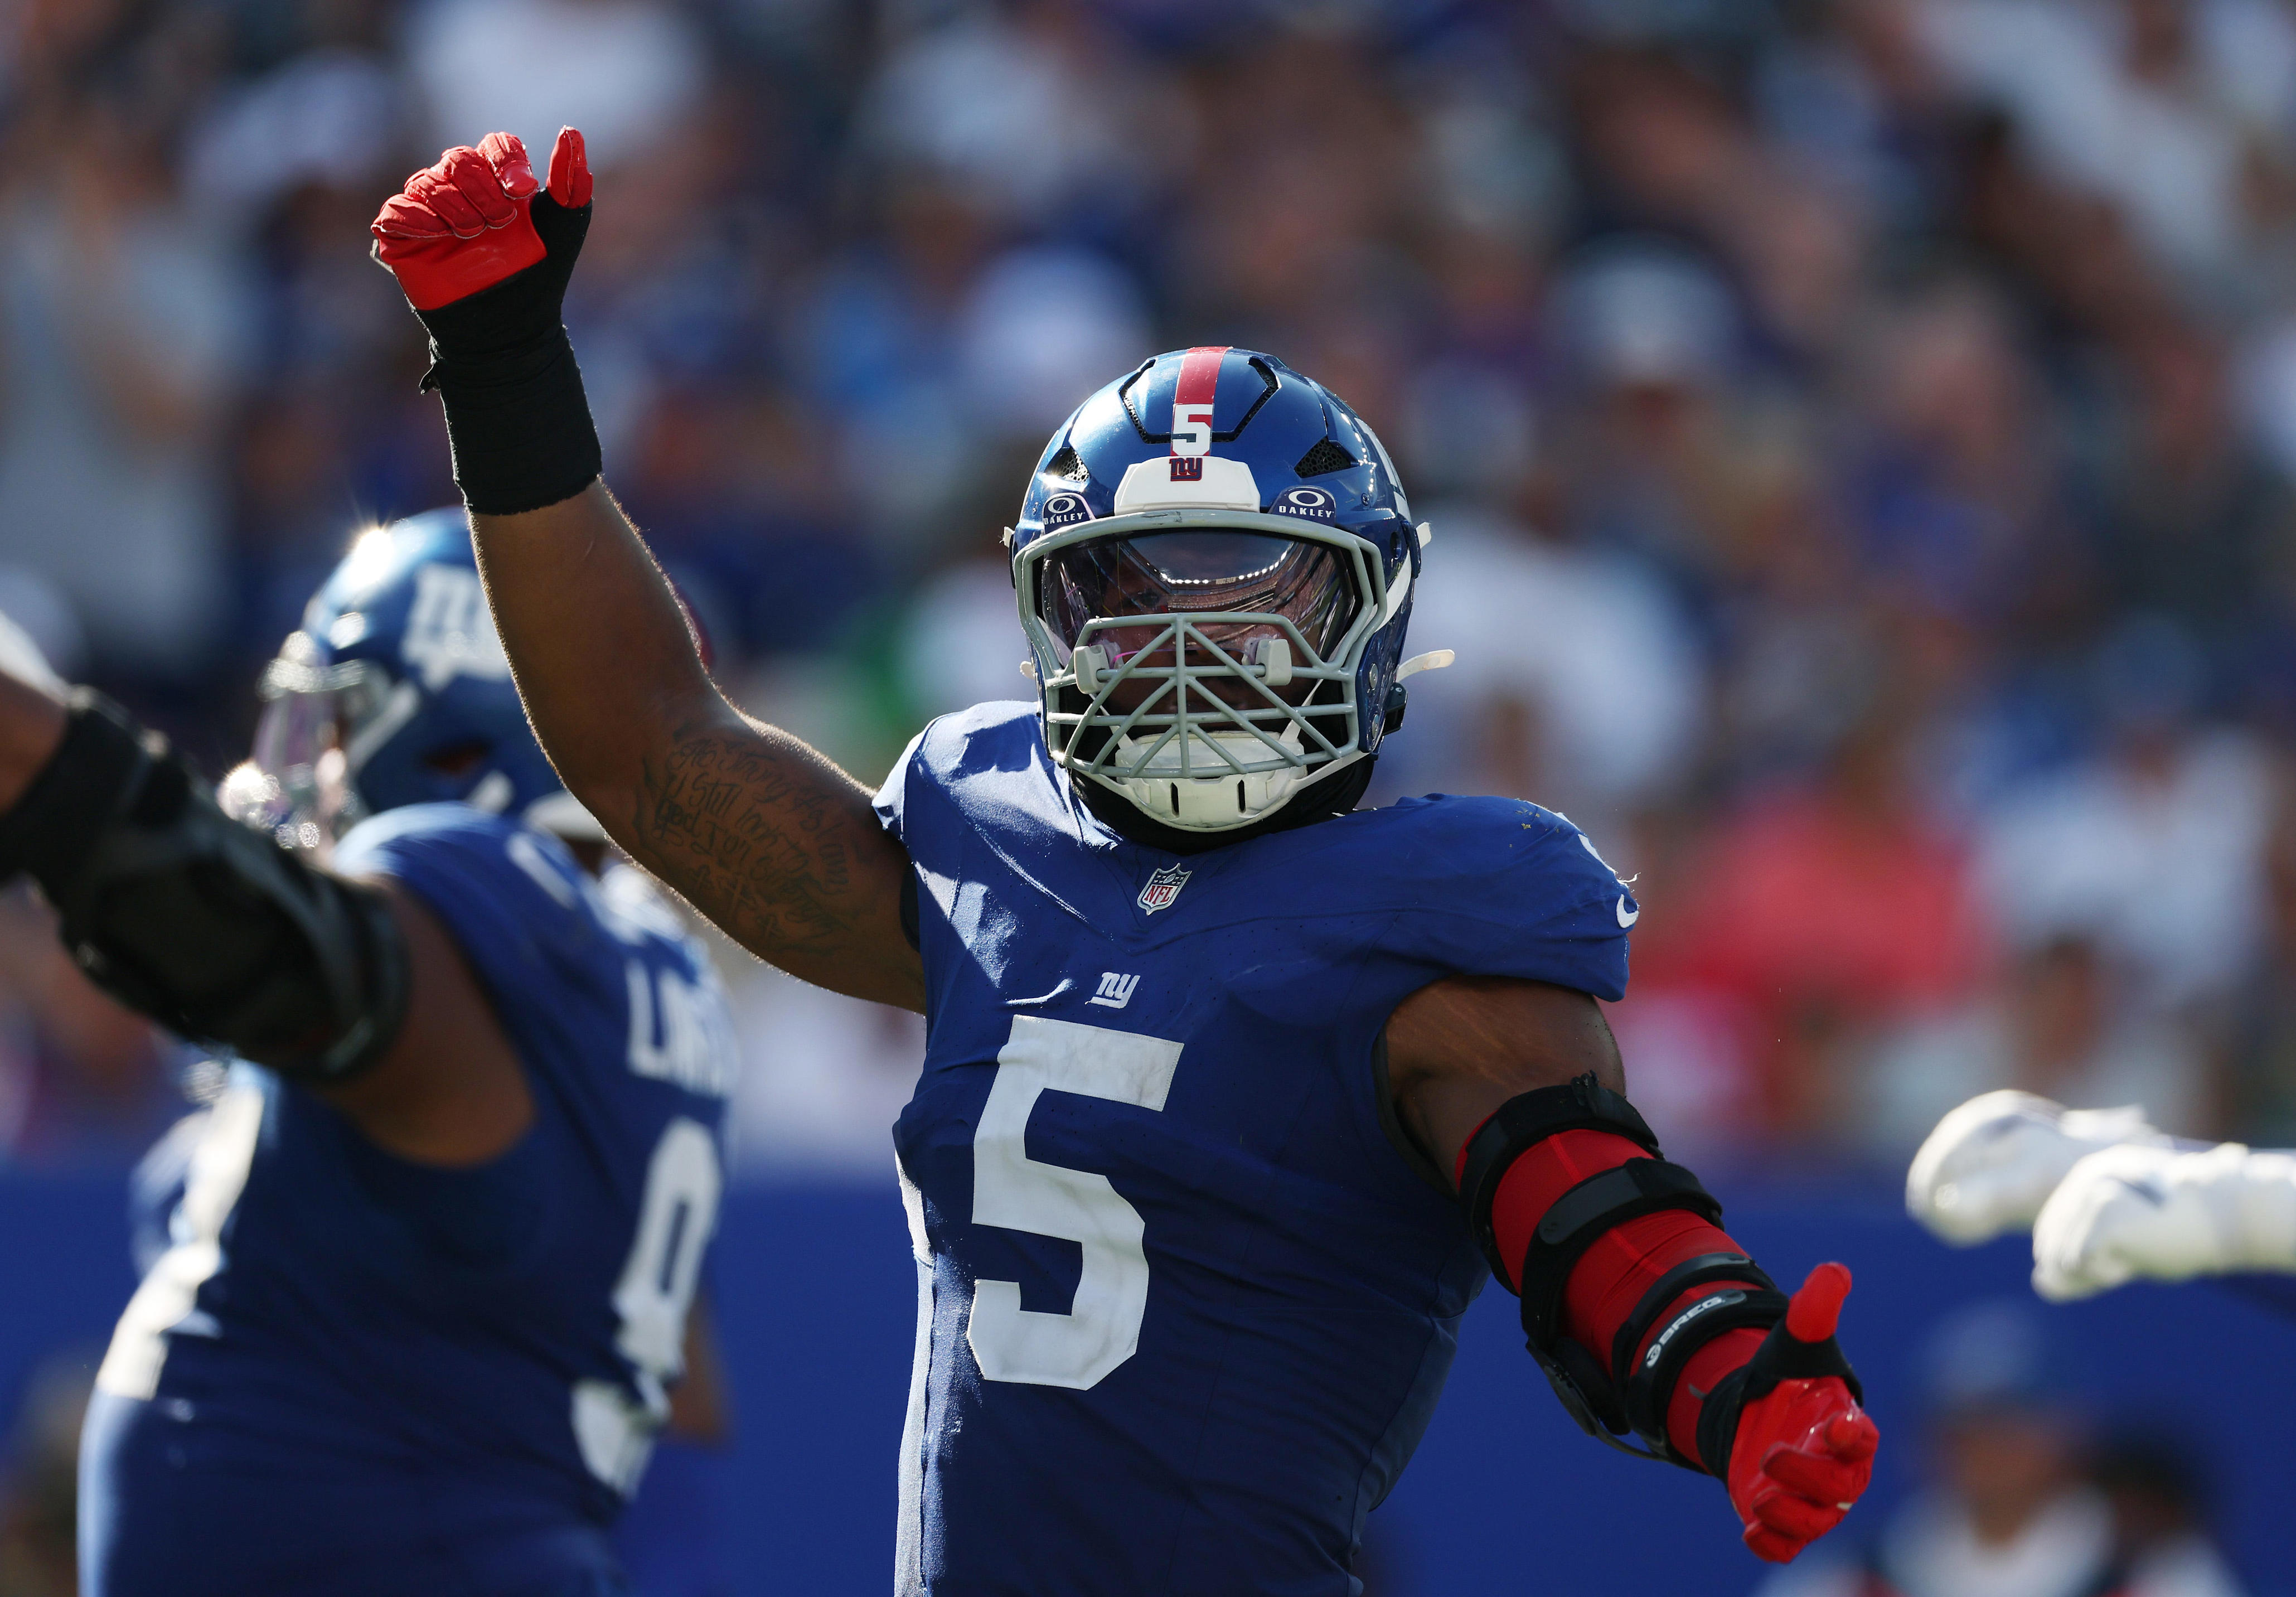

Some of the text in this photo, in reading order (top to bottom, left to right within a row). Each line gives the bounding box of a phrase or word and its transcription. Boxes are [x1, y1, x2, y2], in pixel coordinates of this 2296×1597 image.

[1173, 404, 1214, 456] 5
[1044, 512, 1083, 525] OAKLEY
[1279, 505, 1332, 518] OAKLEY
[1144, 885, 1175, 905] NFL
[966, 1014, 1184, 1391] 5
[1658, 1296, 1723, 1346] BREG
